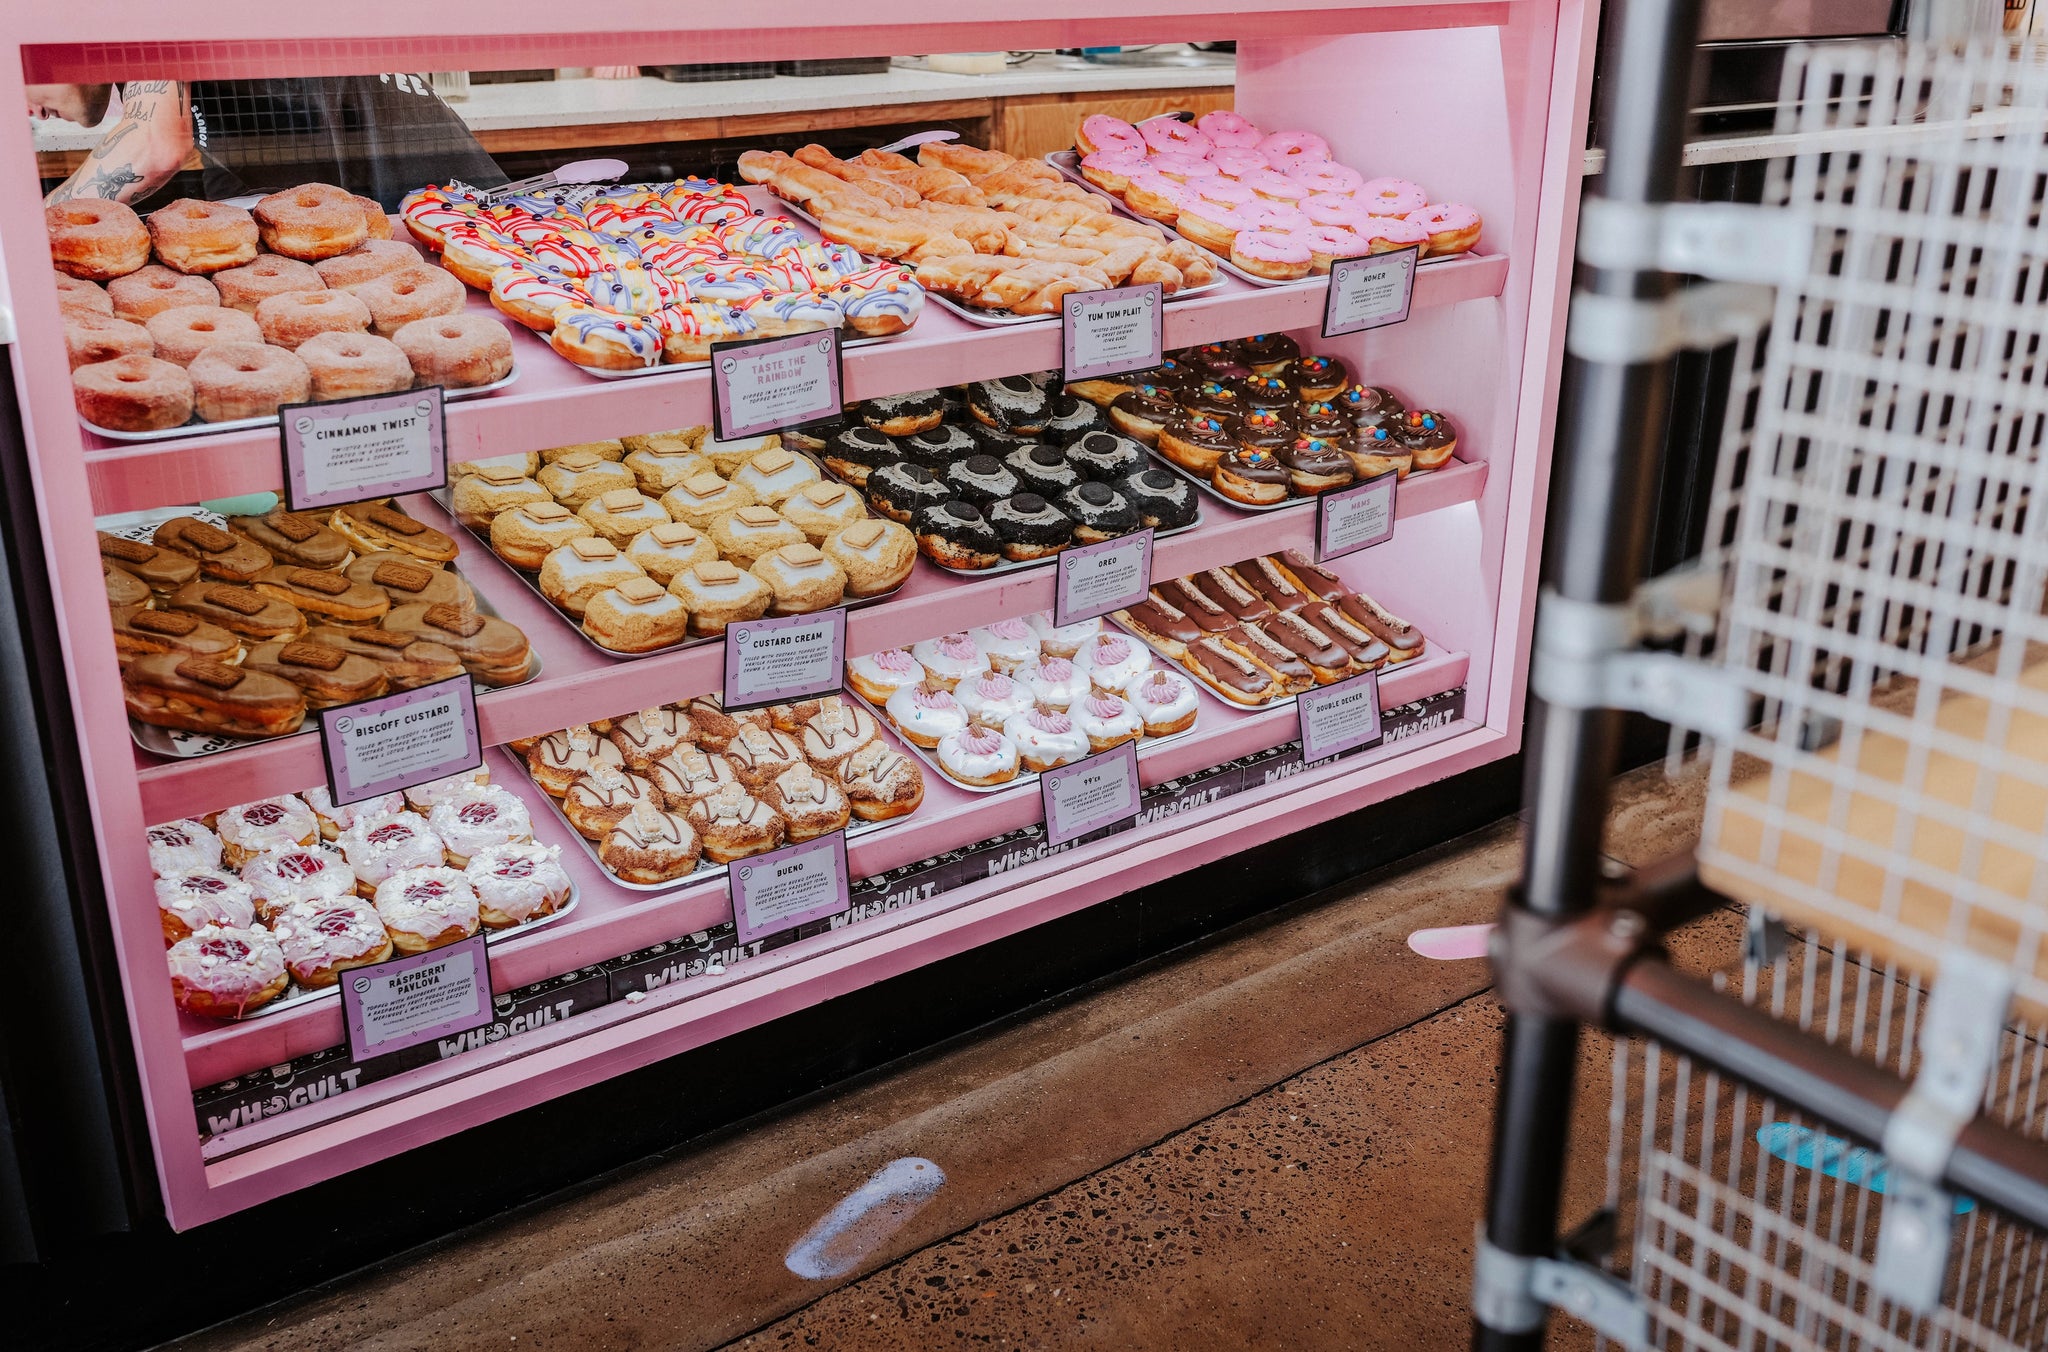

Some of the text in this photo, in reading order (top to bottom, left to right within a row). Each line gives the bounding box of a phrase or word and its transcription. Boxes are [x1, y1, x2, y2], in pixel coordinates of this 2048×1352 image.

[191, 104, 208, 148] DONUTS
[1088, 306, 1141, 321] YUM YUM PLAIT
[751, 355, 805, 375] TASTE THE
[757, 367, 802, 384] RAINBOW
[316, 423, 377, 440] CINNAMON
[382, 417, 416, 430] TWIST
[1098, 556, 1116, 568] OREO
[753, 631, 822, 649] CUSTARD CREAM
[1316, 700, 1339, 713] DOUBLE
[1341, 692, 1362, 705] DECKER
[355, 718, 400, 737] BISCOFF
[404, 704, 449, 724] CUSTARD
[776, 862, 803, 877] BUENO
[388, 963, 446, 988] RASPBERRY
[397, 975, 440, 995] PAVLOVA
[367, 1001, 387, 1012] TOPPED
[390, 997, 403, 1005] WITH
[406, 987, 436, 1000] RASPBERRY
[438, 982, 454, 990] WHITE
[373, 1002, 405, 1016] RASPBERRY
[407, 997, 422, 1005] FRUIT
[425, 991, 445, 1000] PUDDLE
[447, 983, 470, 993] CRUSHED
[373, 1009, 402, 1022] MERINGUE
[410, 1002, 427, 1011] WHITE
[429, 997, 443, 1005] CHOC
[446, 990, 467, 1000] DRIZZLE
